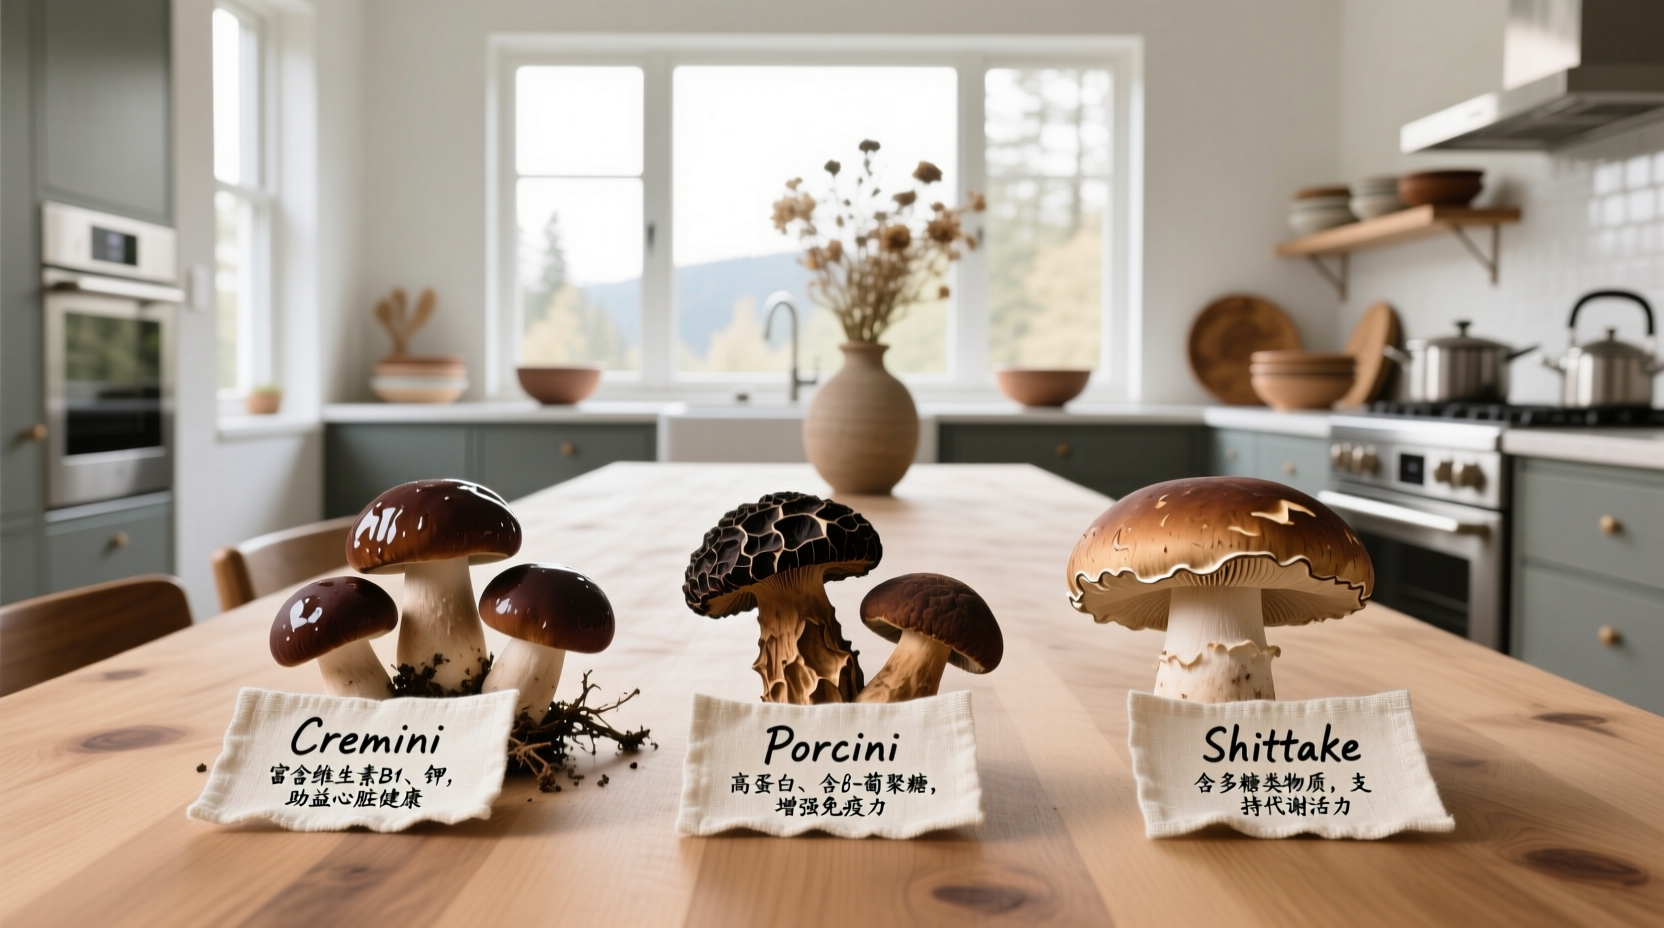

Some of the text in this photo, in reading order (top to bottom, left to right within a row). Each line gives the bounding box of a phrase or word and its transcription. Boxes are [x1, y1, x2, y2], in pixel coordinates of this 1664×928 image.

[291, 717, 444, 755] Cremini
[764, 725, 900, 765] Porcini
[1203, 723, 1362, 763] Shittake
[285, 786, 423, 809] 助益心脏健康
[775, 796, 886, 817] 增强免疫力
[1240, 796, 1351, 817] 持代谢活力
